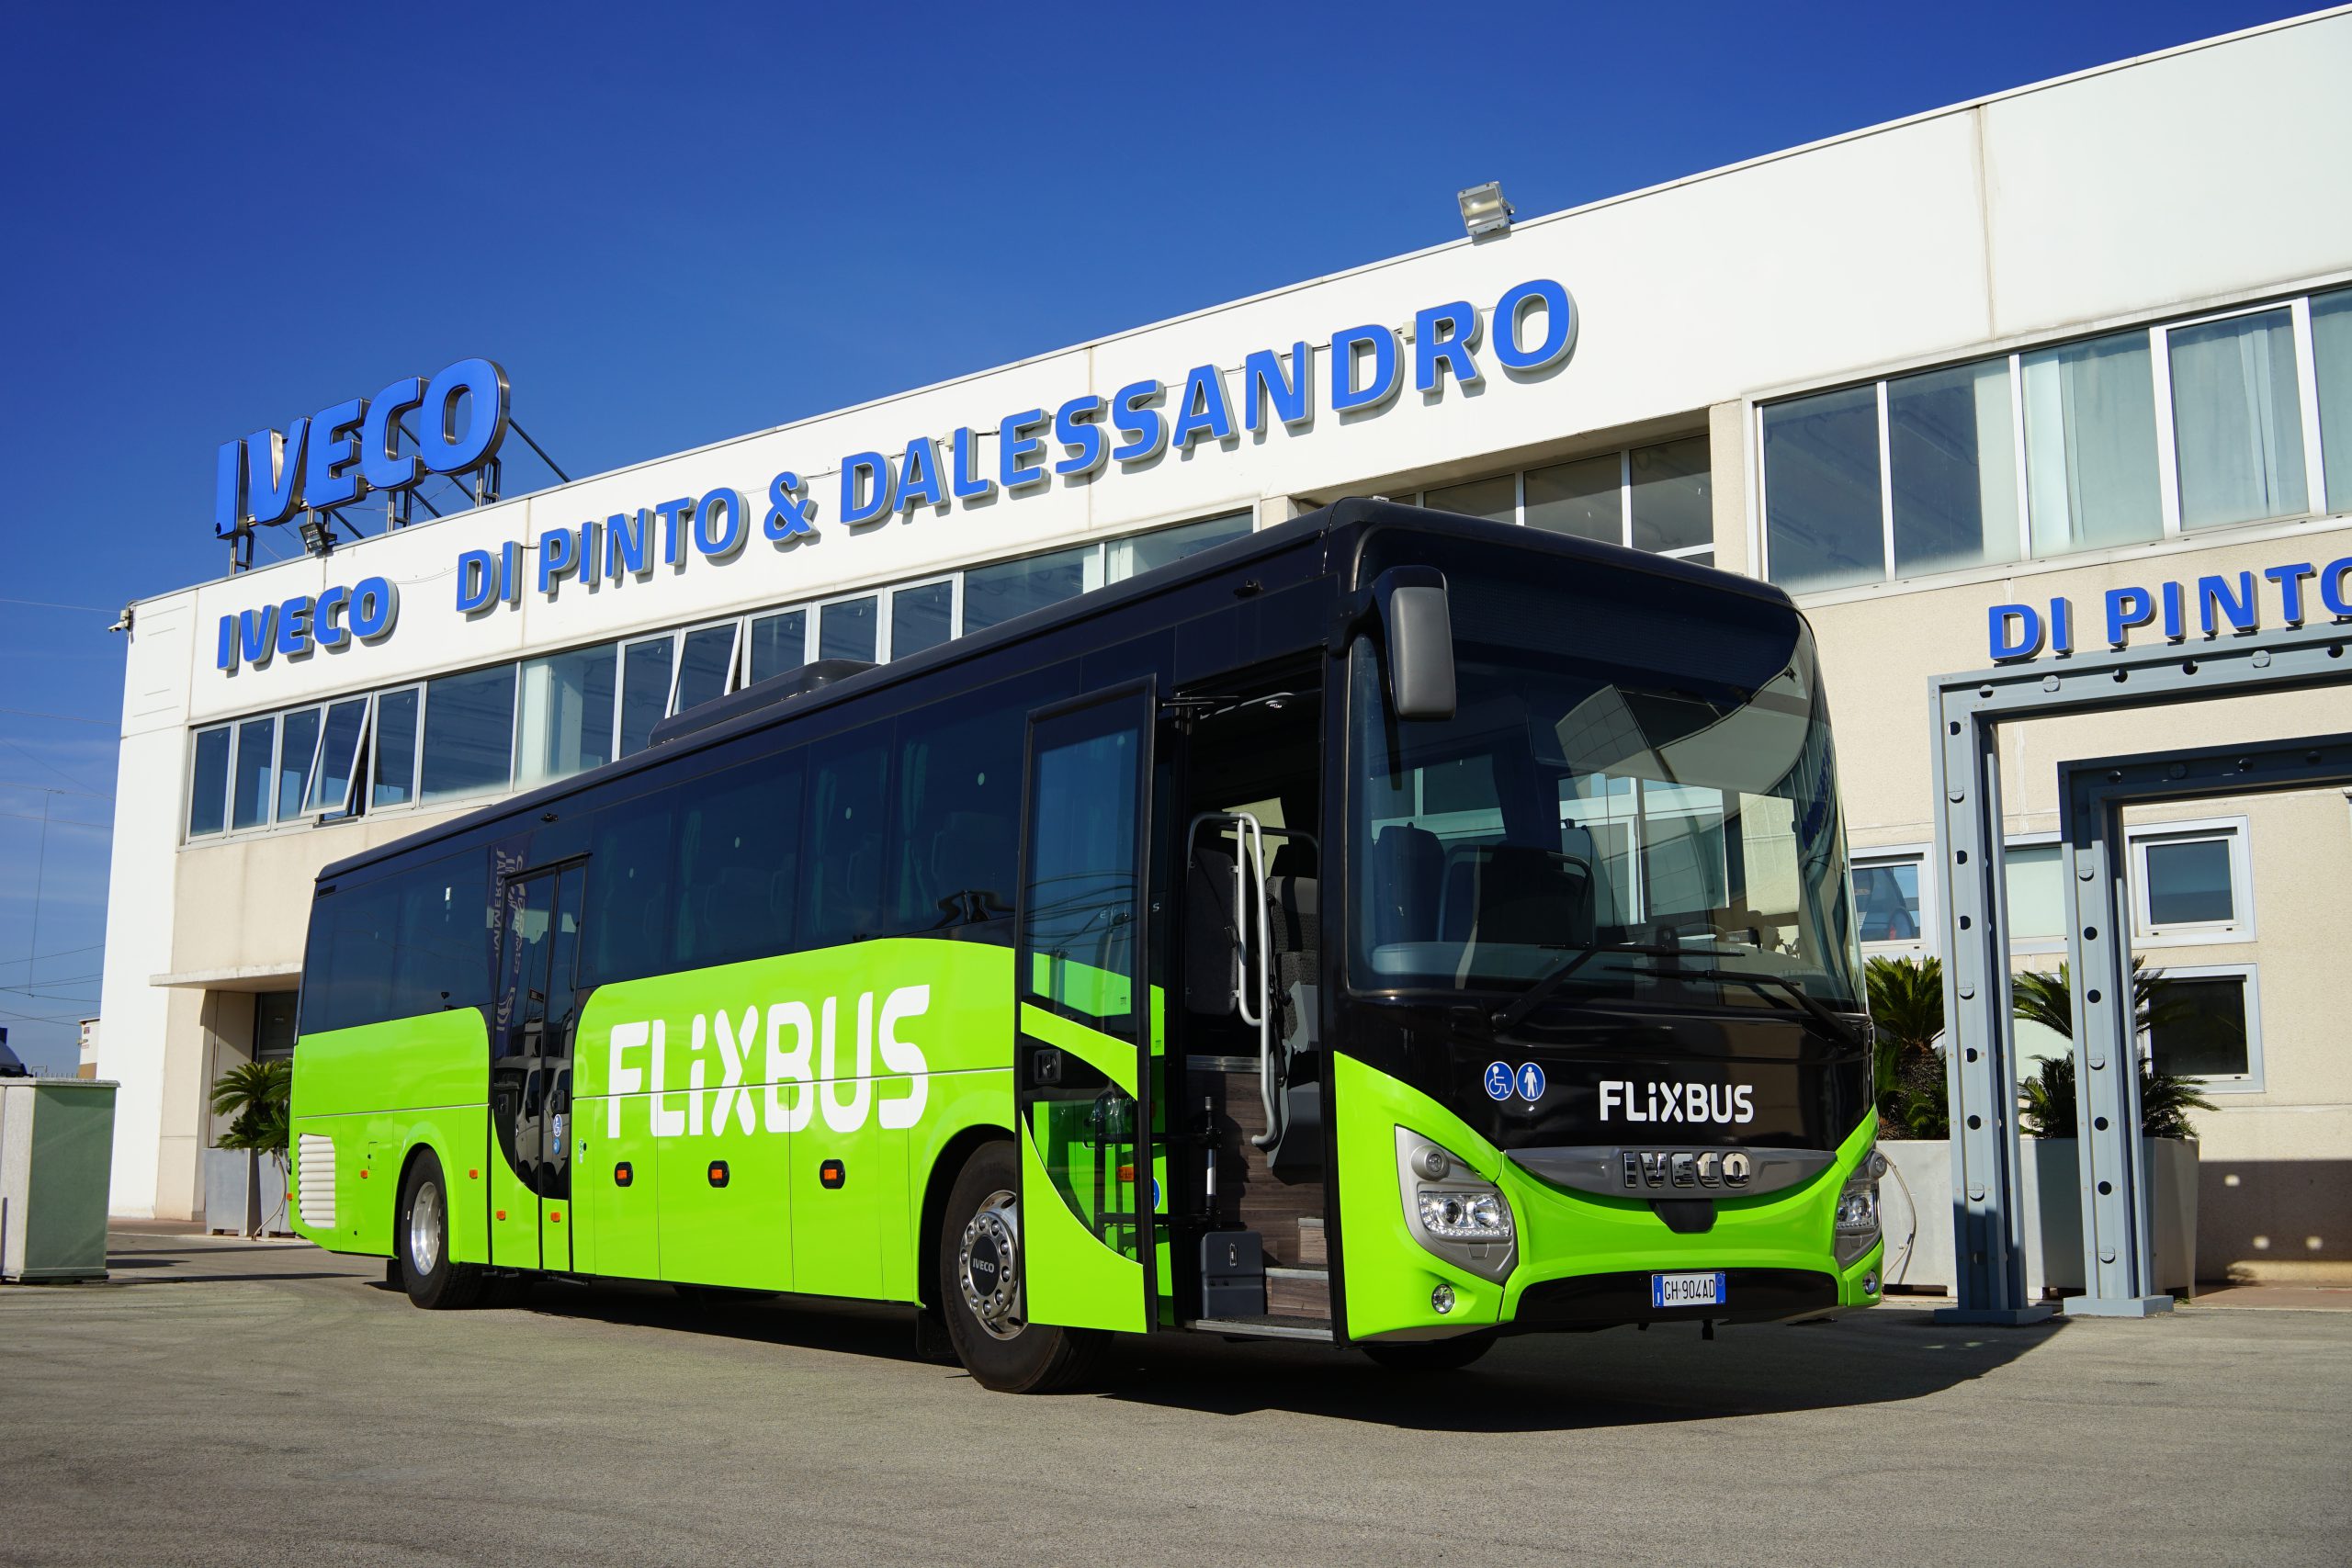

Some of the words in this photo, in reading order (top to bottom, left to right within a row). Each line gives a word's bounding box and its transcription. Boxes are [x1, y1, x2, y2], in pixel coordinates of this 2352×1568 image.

[215, 357, 509, 540] IVECO
[217, 576, 399, 671] IVECO
[457, 540, 520, 615] DI
[538, 487, 748, 594] PINTO
[763, 470, 820, 543] &
[840, 278, 1577, 525] DALESSANDRO
[1988, 596, 2073, 661] DI
[1623, 1151, 1750, 1189] IVECO
[973, 1258, 994, 1274] IVECO
